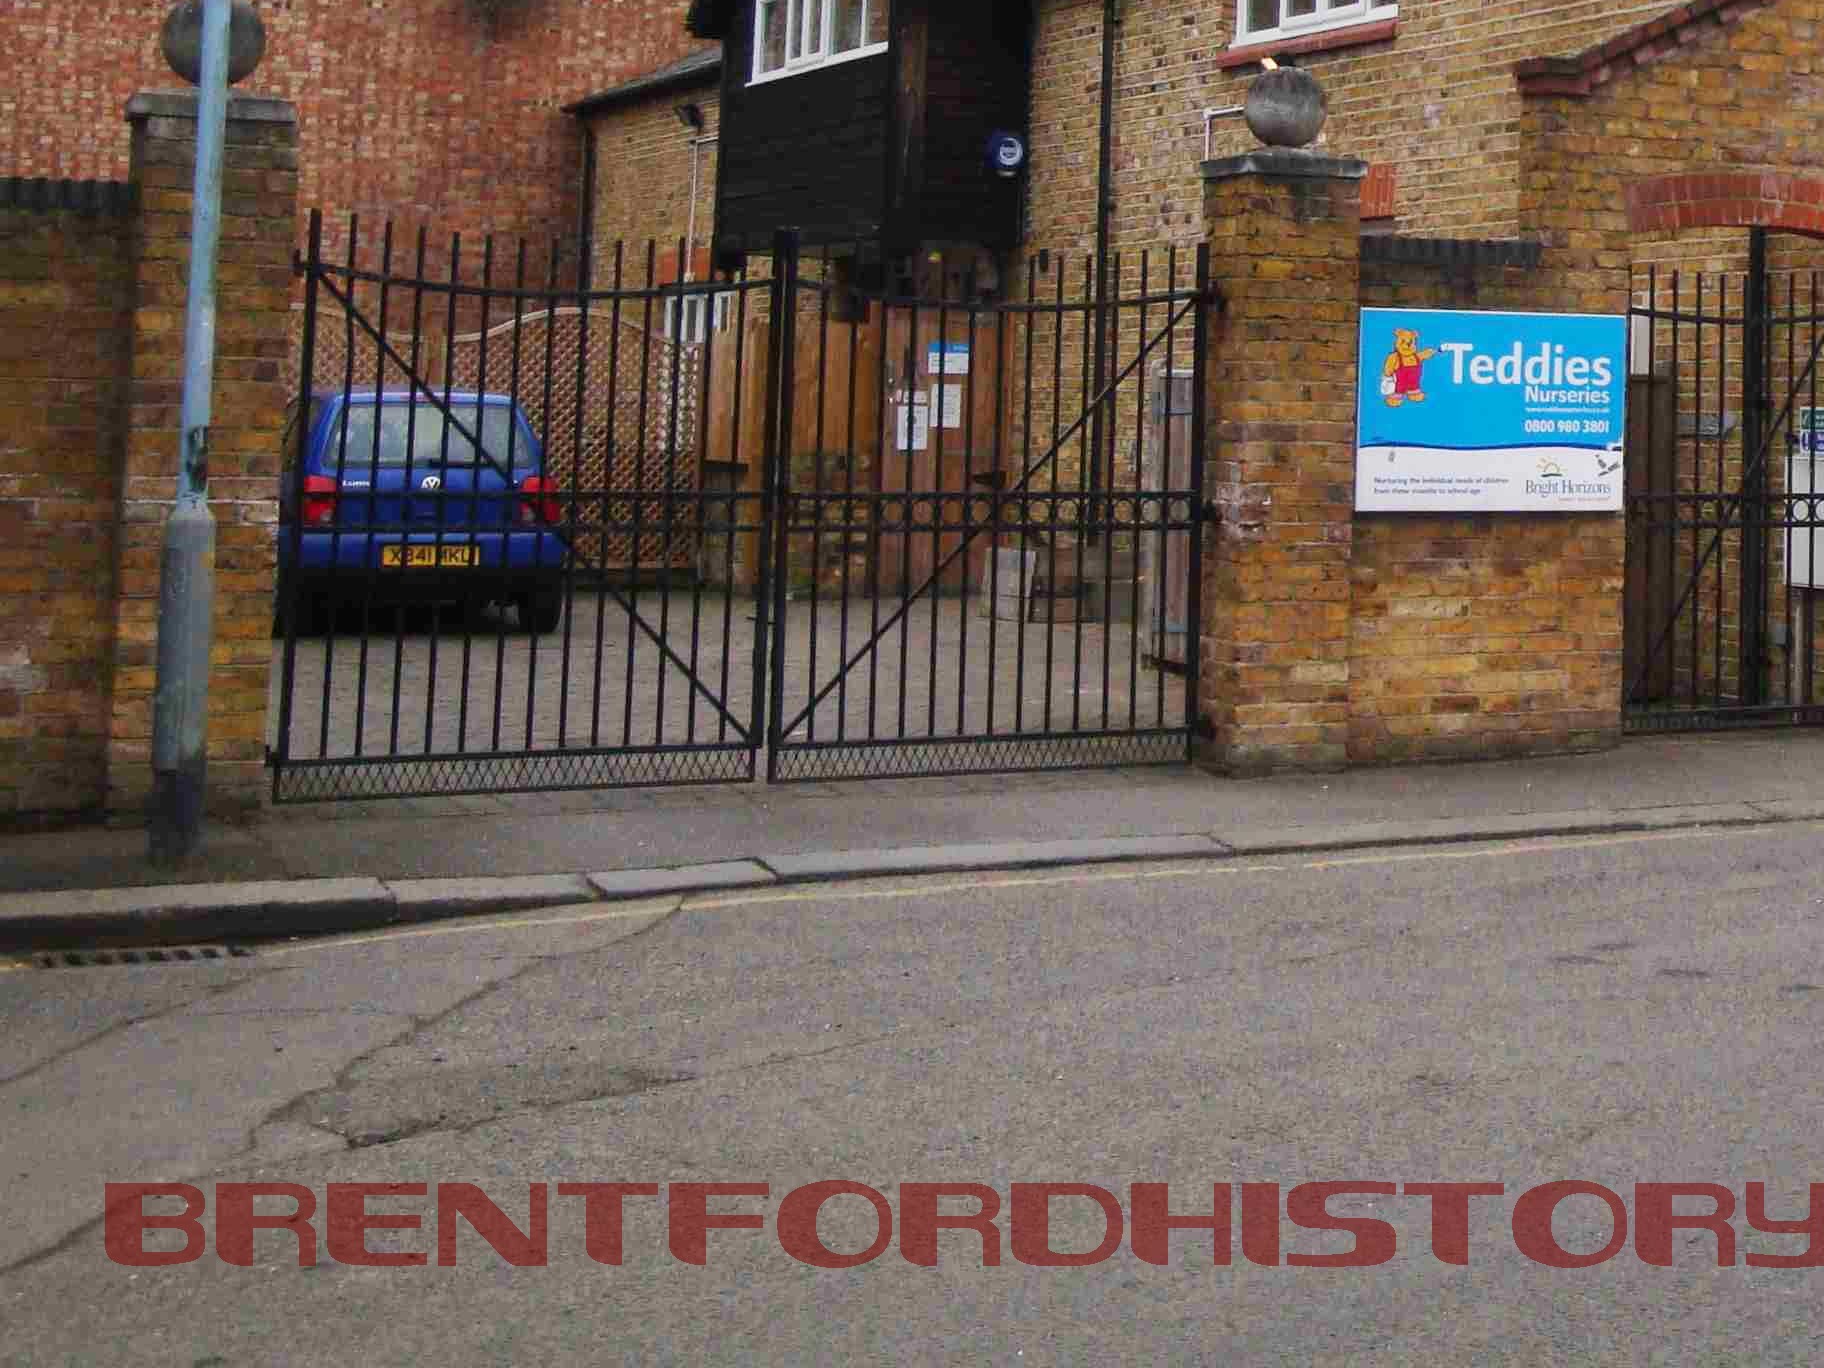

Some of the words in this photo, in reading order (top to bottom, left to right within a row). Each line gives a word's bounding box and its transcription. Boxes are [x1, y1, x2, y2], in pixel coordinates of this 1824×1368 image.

[1441, 341, 1612, 386] Teddies
[1524, 385, 1610, 404] Nurseries
[1524, 419, 1555, 433] 0800
[1557, 419, 1581, 433] 980
[1582, 419, 1610, 434] 3801
[1525, 479, 1559, 498] Bright
[1562, 479, 1611, 494] Horizons
